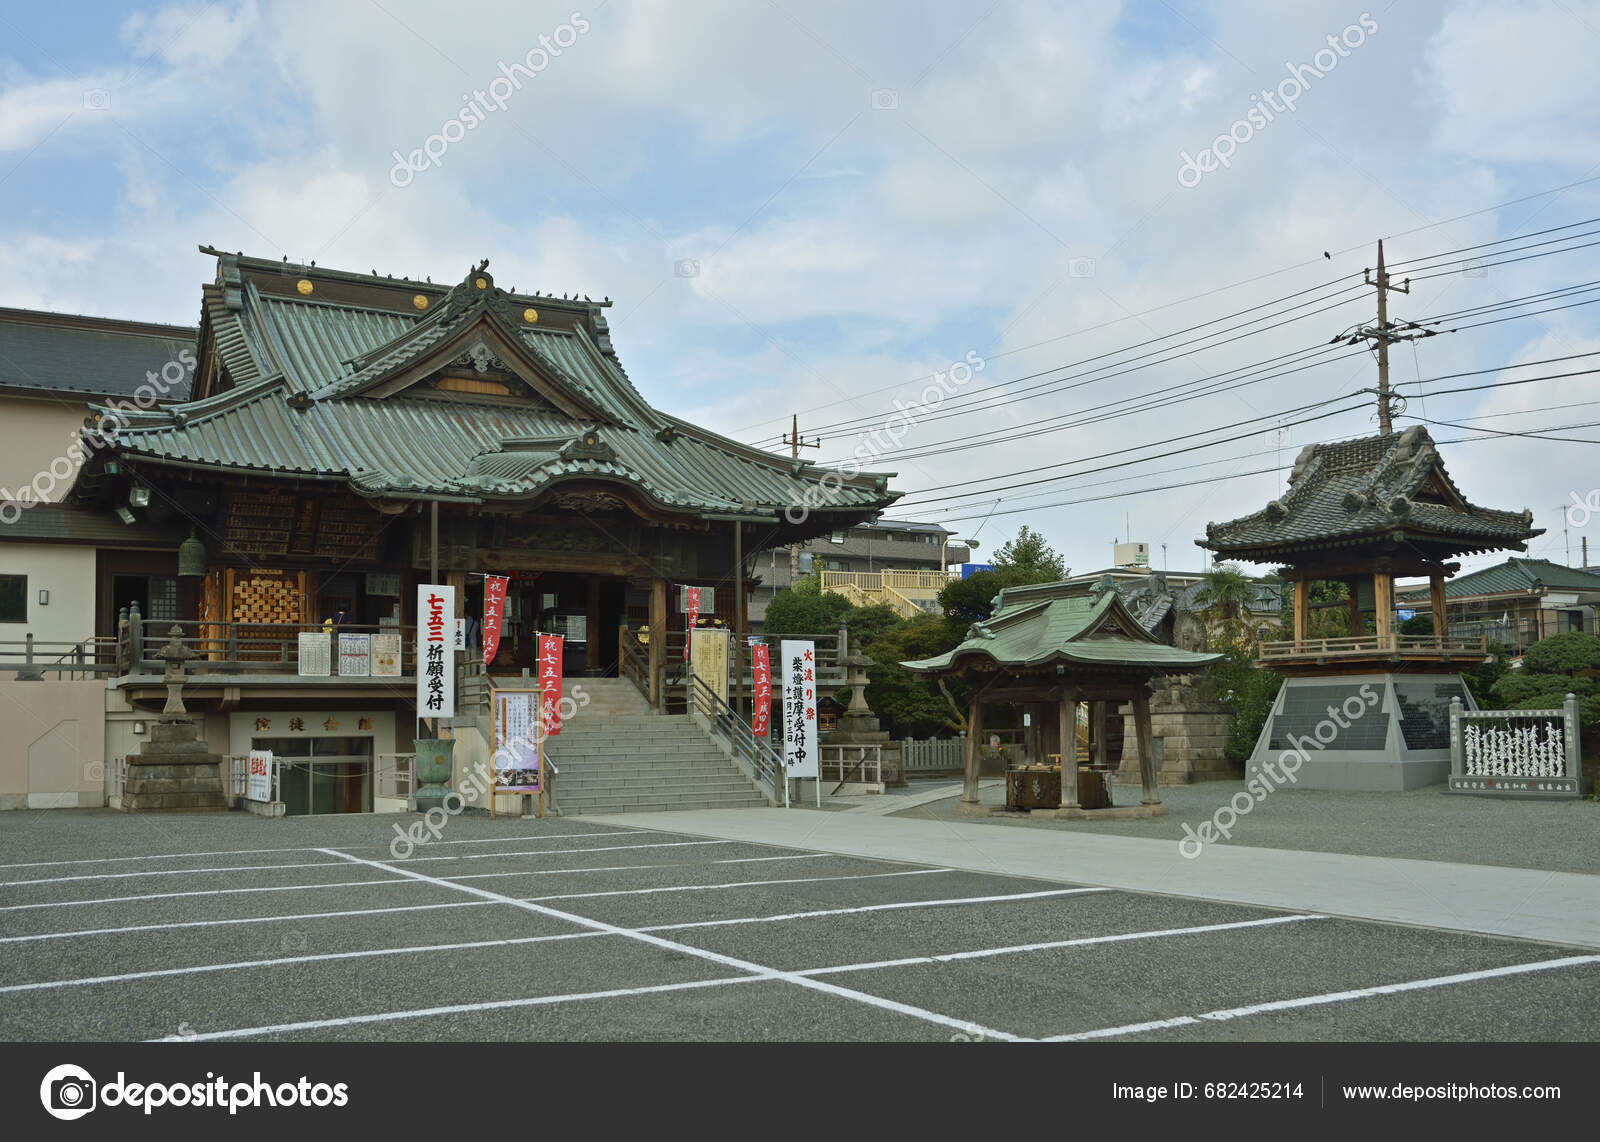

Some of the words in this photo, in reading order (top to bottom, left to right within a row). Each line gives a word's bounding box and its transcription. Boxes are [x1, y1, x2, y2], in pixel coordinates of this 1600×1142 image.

[425, 593, 445, 710] 七五三祈願受付
[804, 648, 816, 721] 火渡り祭
[785, 686, 793, 742] 十一月二十三日
